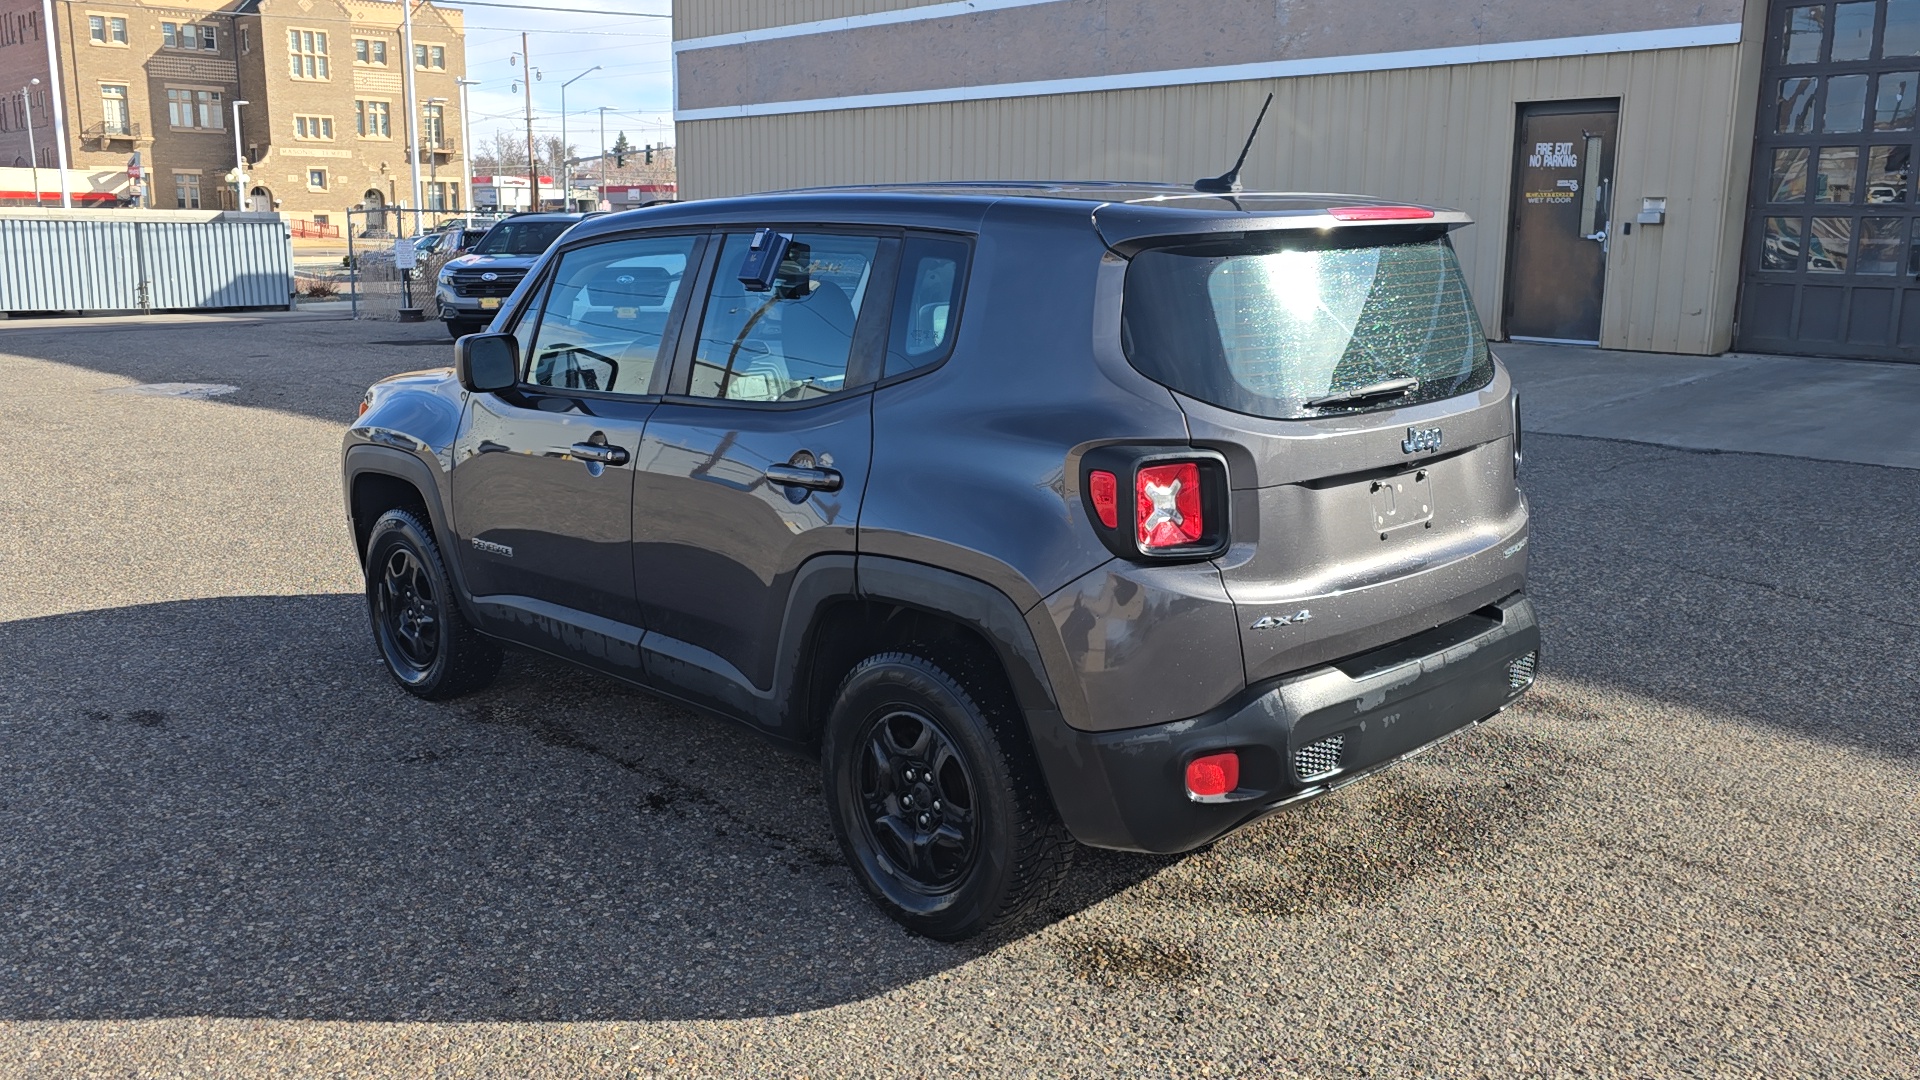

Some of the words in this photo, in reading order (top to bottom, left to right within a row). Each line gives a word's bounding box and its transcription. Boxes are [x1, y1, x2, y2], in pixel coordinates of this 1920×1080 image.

[1536, 142, 1553, 155] FIRE
[1555, 142, 1573, 155] EXIT
[1529, 154, 1541, 167] NO
[1543, 154, 1577, 167] PARKING
[1401, 426, 1442, 454] Jeep
[471, 537, 513, 557] RENEGADE
[1250, 609, 1313, 630] 4x4
